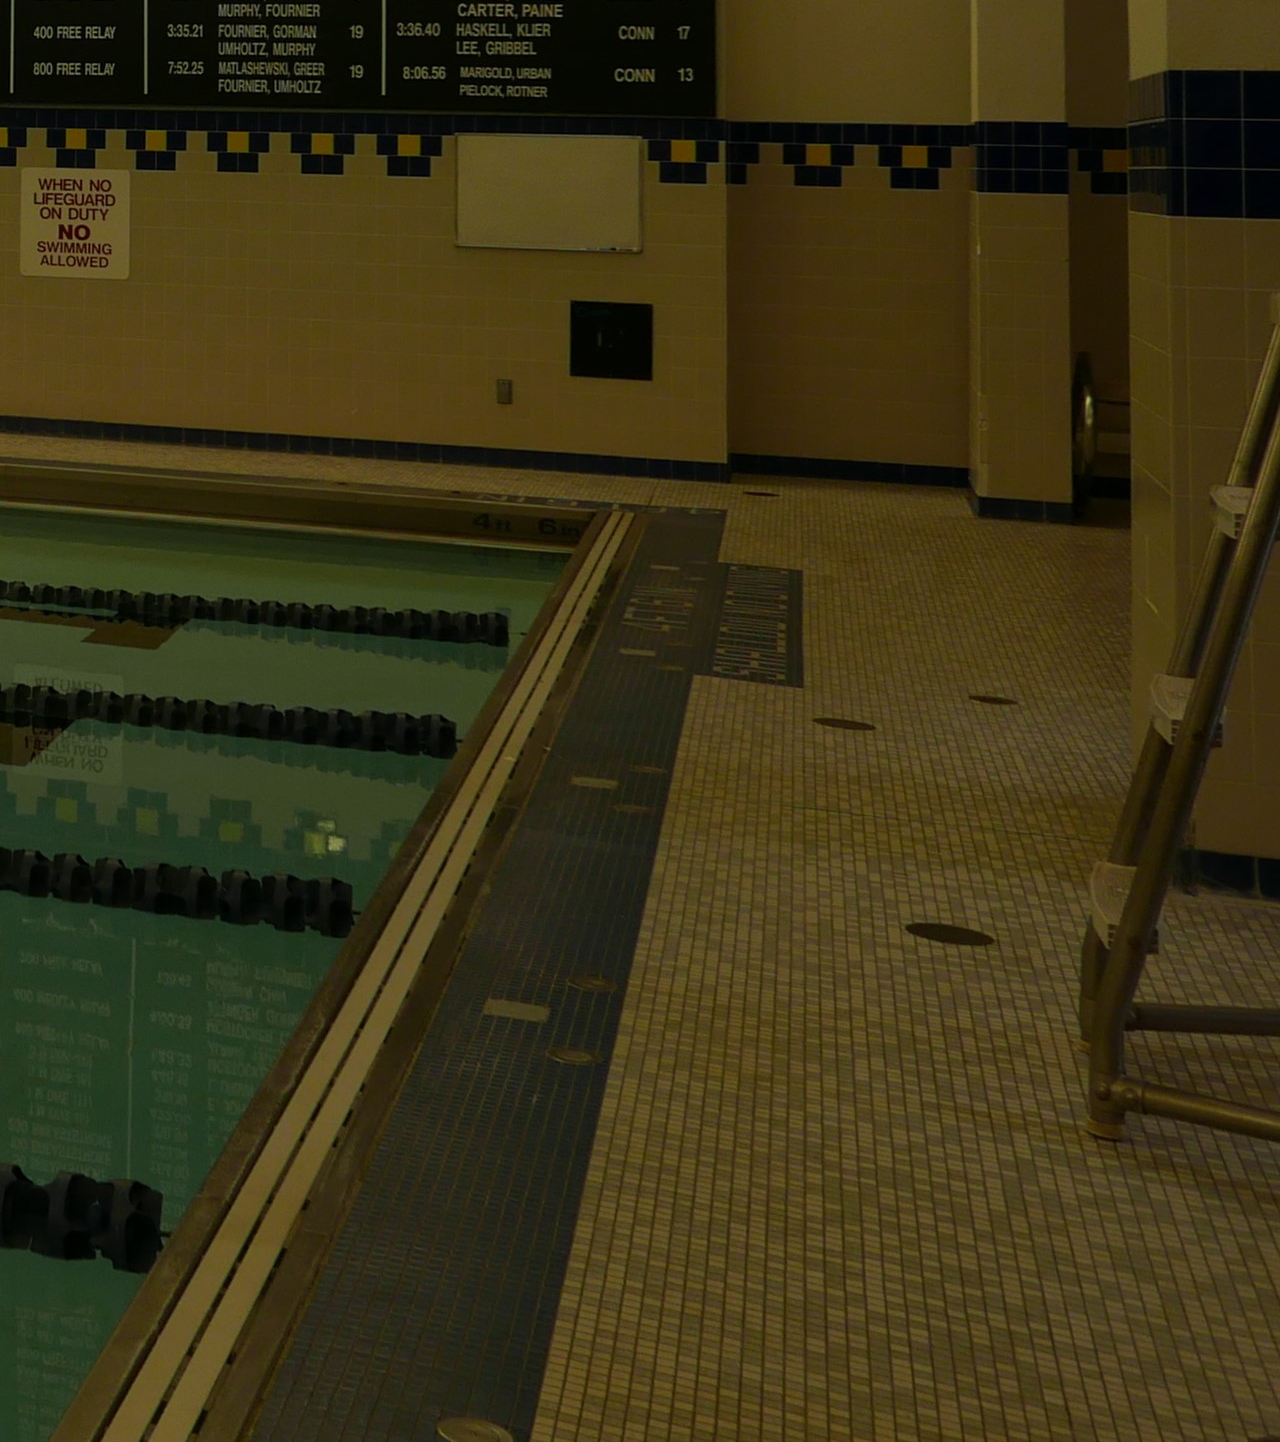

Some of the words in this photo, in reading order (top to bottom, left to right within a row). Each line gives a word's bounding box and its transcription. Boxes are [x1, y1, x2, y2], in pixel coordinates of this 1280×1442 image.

[32, 61, 54, 76] 800
[56, 62, 82, 76] FREE
[84, 62, 116, 76] RELAY
[38, 178, 83, 191] WHEN
[89, 179, 111, 192] NO
[33, 192, 116, 207] LIFEGUARD
[40, 207, 62, 220] ON
[68, 207, 109, 221] DUTY
[57, 225, 90, 241] NO
[37, 241, 112, 256] SWIMMING
[40, 255, 109, 269] ALLOWED
